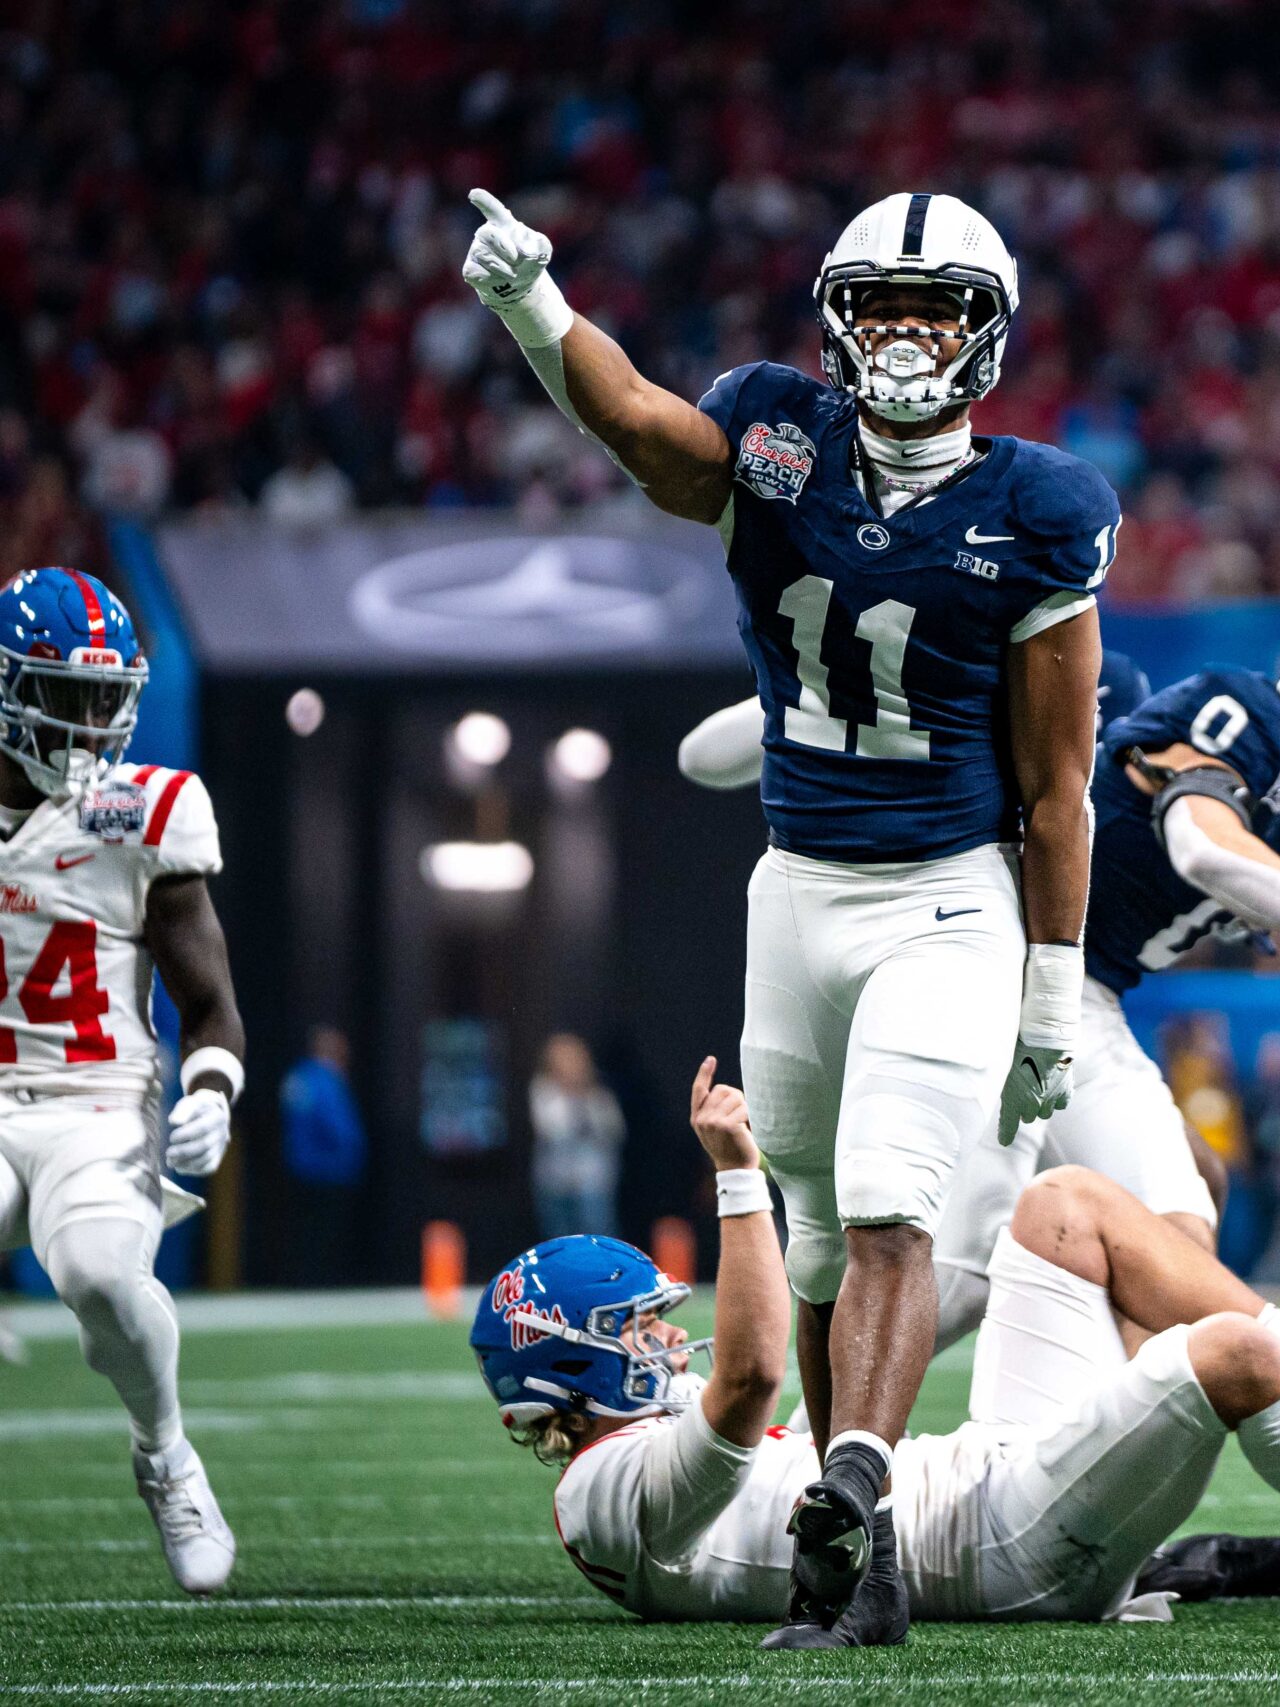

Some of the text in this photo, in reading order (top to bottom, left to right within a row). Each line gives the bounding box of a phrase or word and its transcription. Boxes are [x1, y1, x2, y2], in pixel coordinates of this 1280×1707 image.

[738, 452, 804, 491] PEACH
[748, 472, 786, 491] BOWL
[777, 574, 930, 761] 11
[1190, 695, 1250, 755] 0
[492, 1266, 525, 1312] Ole
